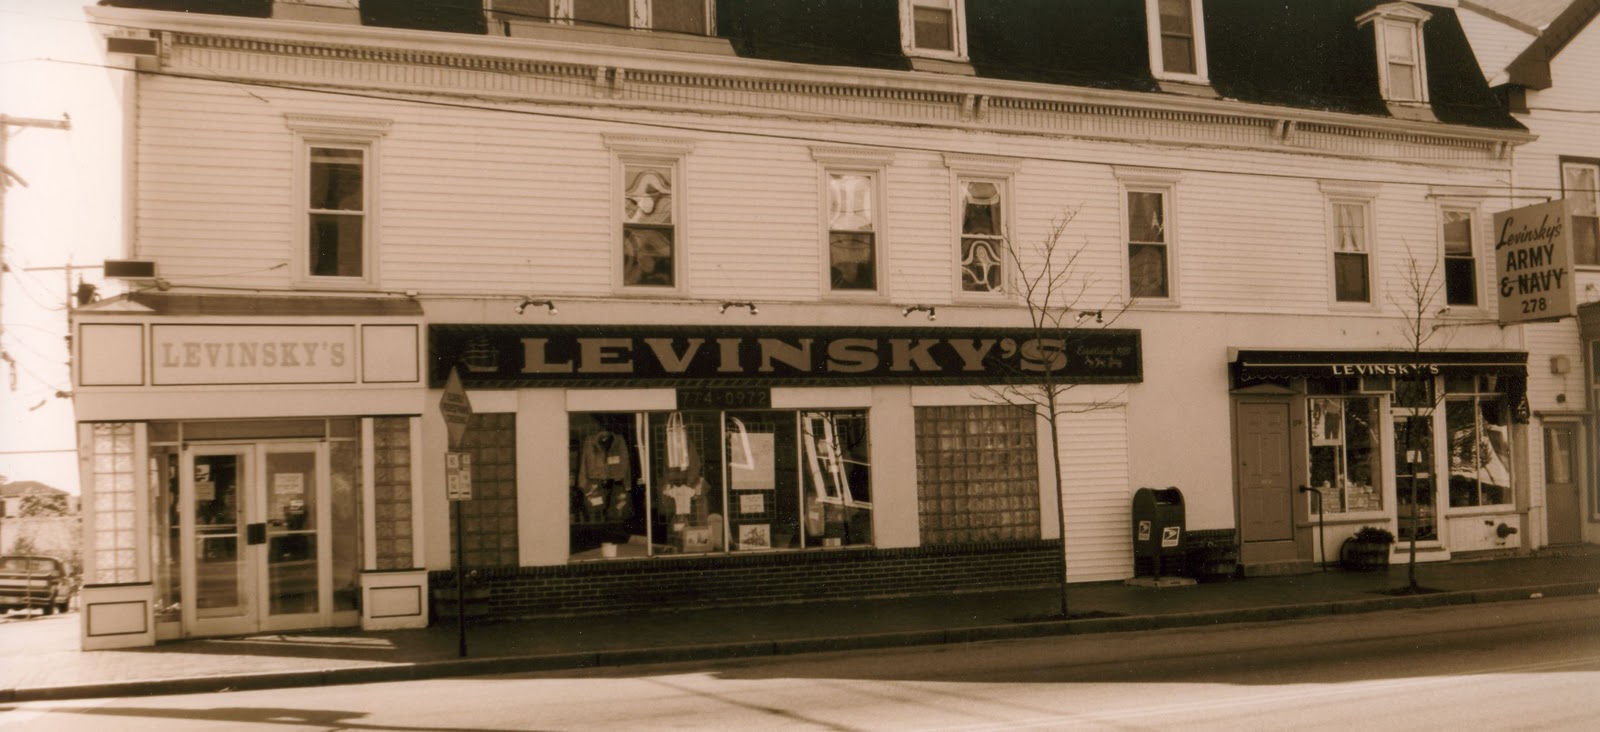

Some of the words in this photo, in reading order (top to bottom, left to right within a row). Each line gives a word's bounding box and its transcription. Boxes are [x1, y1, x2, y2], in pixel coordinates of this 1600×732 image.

[1495, 214, 1563, 250] Levinsky's
[1506, 243, 1554, 272] ARMY
[1500, 276, 1514, 298] &
[1517, 267, 1564, 295] NAVY
[1521, 297, 1547, 314] 278
[160, 340, 347, 369] LEVINSKY'S
[519, 336, 1069, 374] LEVINSKY'S
